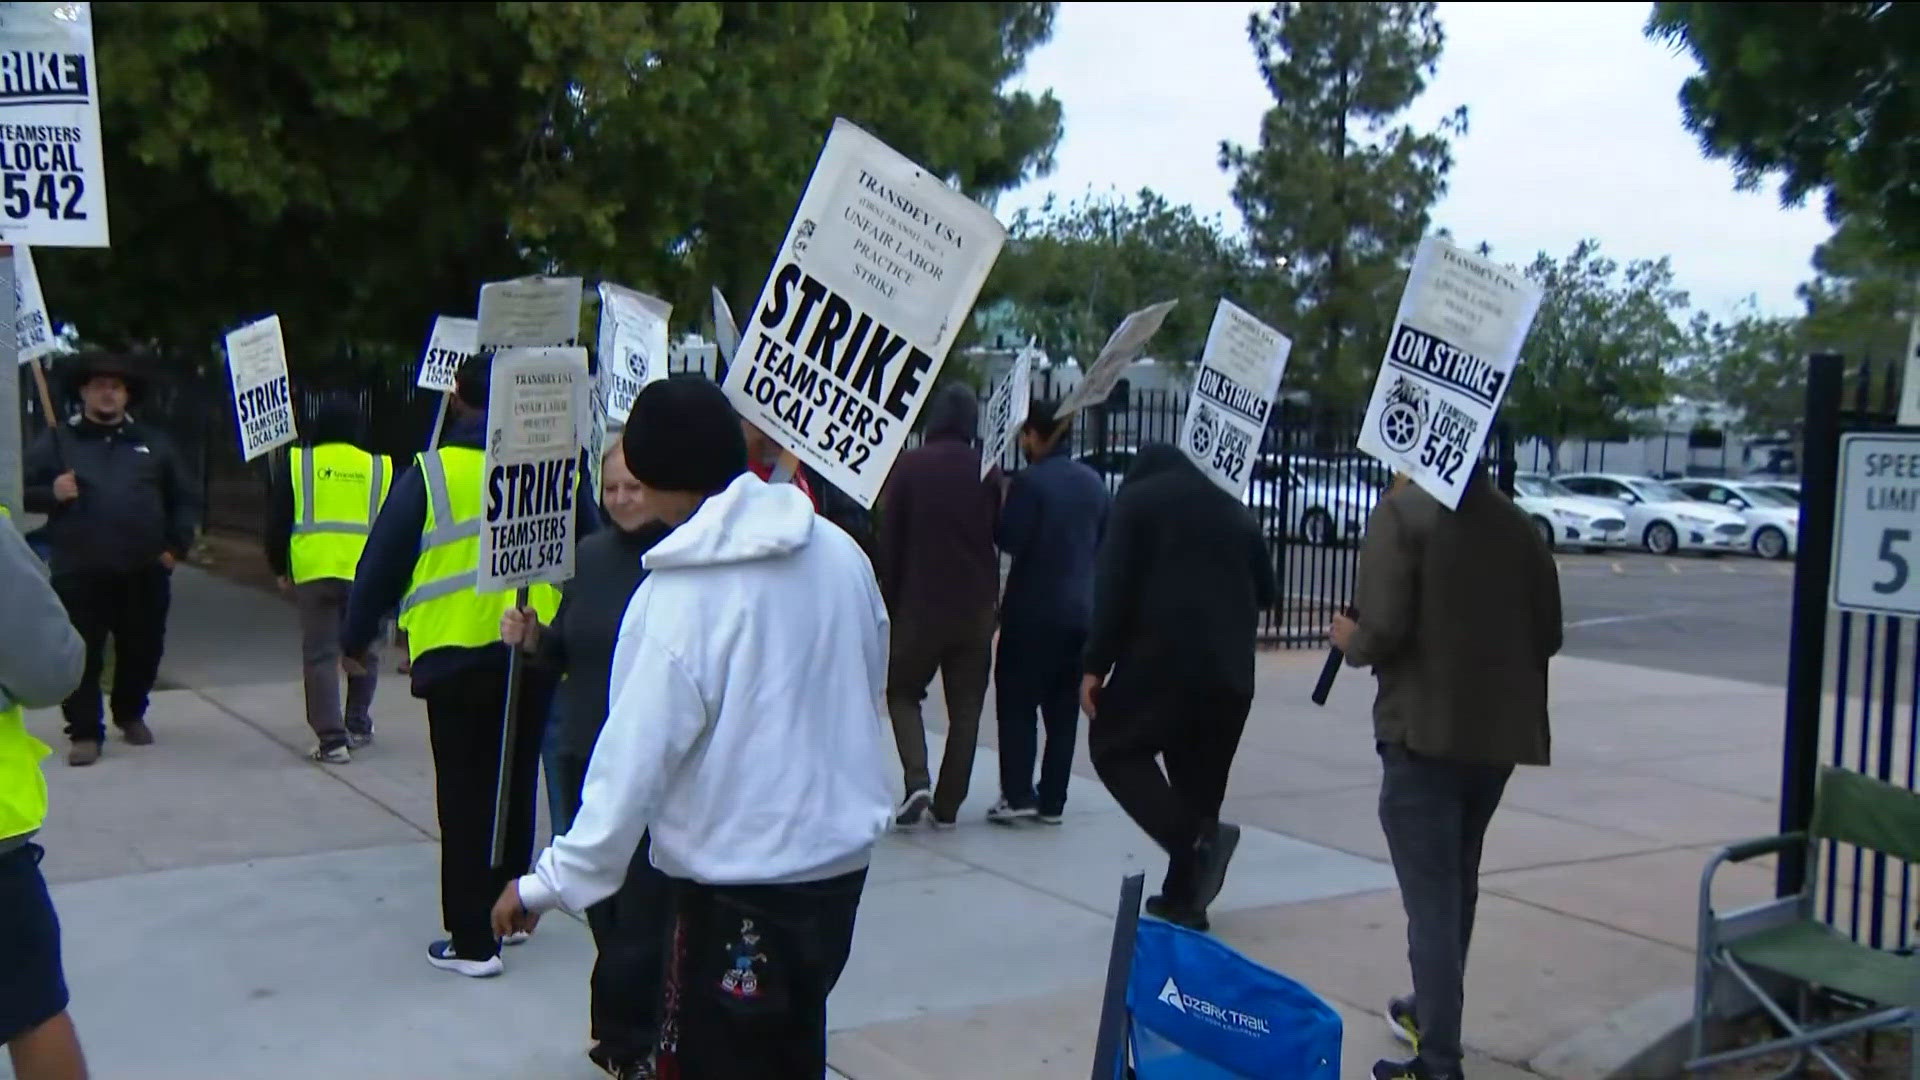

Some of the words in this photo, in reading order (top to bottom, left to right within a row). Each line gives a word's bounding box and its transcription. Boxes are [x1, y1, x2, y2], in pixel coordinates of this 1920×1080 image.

[0, 124, 81, 143] TEAMSTERS
[0, 142, 83, 172] LOCAL
[4, 172, 87, 220] 542
[859, 170, 935, 226] TRANSDEV
[935, 222, 962, 248] USA
[845, 206, 894, 249] UNFAIR
[895, 241, 944, 282] LABOR
[853, 238, 914, 287] PRACTICE
[852, 263, 897, 298] STRIKE
[760, 263, 933, 422] STRIKE
[1397, 330, 1431, 372] ON
[1429, 342, 1499, 397] STRIKE
[238, 375, 288, 423] STRIKE
[612, 374, 642, 398] TEAM
[753, 332, 889, 446] TEAMSTERS
[1201, 369, 1221, 397] ON
[1219, 380, 1266, 420] STRIKE
[245, 407, 288, 435] TEAMSTERS
[249, 431, 273, 450] LOCAL
[275, 421, 289, 439] 542
[743, 365, 815, 438] LOCAL
[818, 422, 871, 475] 542
[1430, 412, 1471, 453] LOCAL
[1212, 446, 1244, 483] 542
[1219, 429, 1248, 460] LOCAL
[1421, 433, 1464, 486] 542
[487, 458, 576, 523] STRIKE
[491, 515, 566, 550] TEAMSTERS
[491, 547, 532, 577] LOCAL
[537, 541, 563, 568] 542
[1872, 527, 1912, 595] 5
